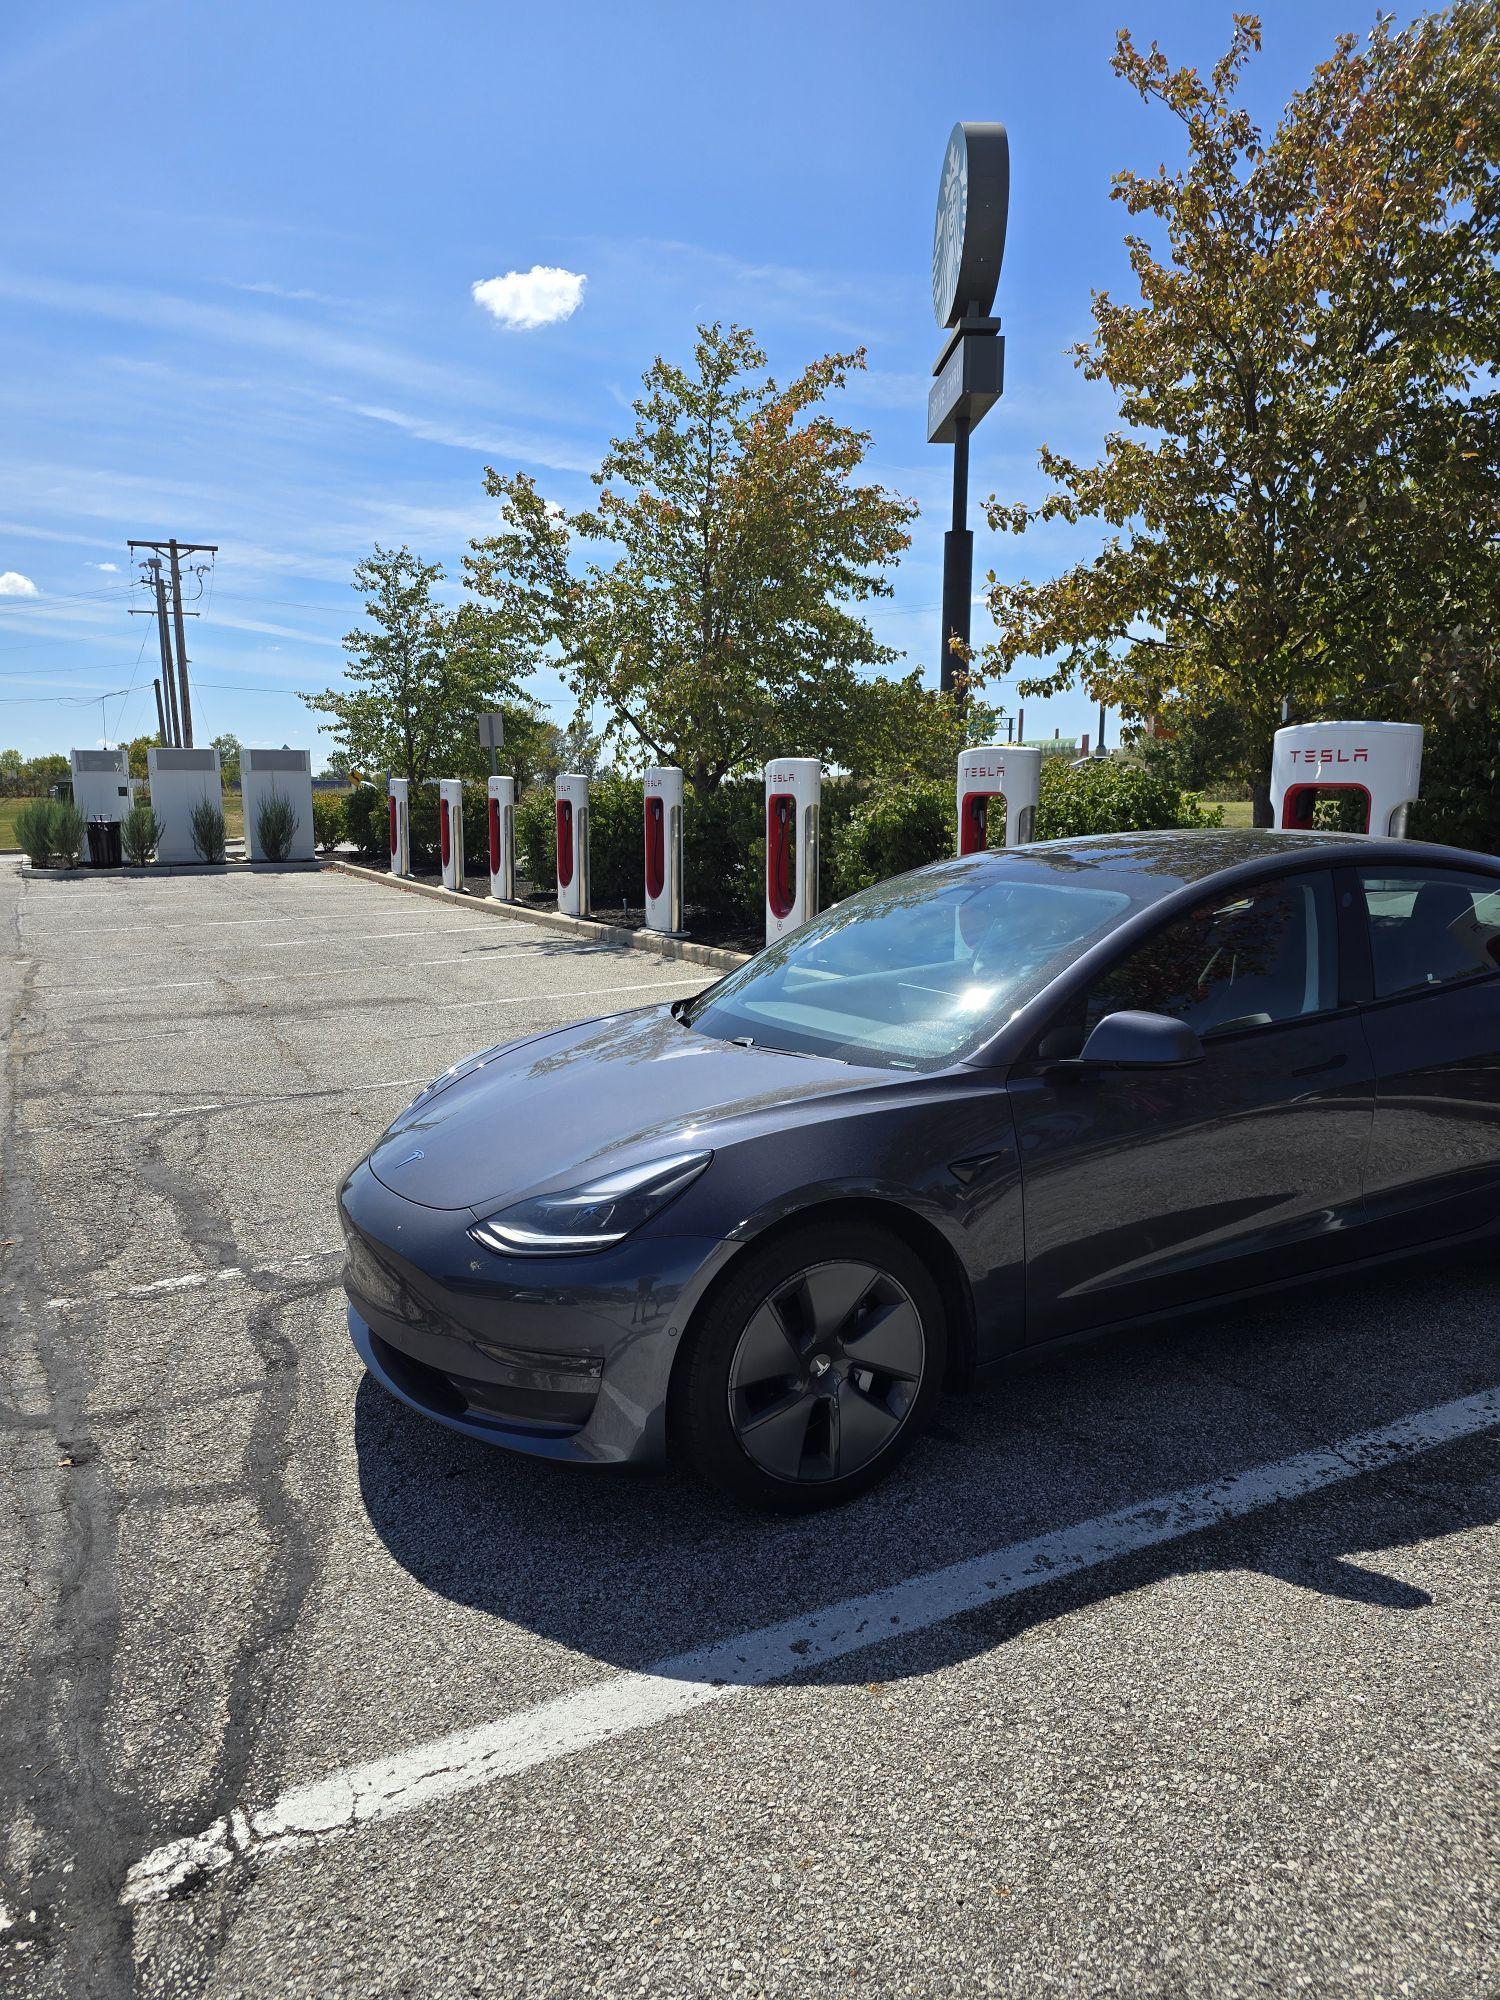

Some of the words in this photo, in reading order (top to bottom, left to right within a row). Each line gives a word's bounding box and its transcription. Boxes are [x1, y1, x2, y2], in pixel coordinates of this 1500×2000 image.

[947, 361, 960, 399] THRU
[1290, 748, 1368, 763] TESLA
[769, 774, 794, 782] TESLA
[964, 766, 1005, 778] TESLA
